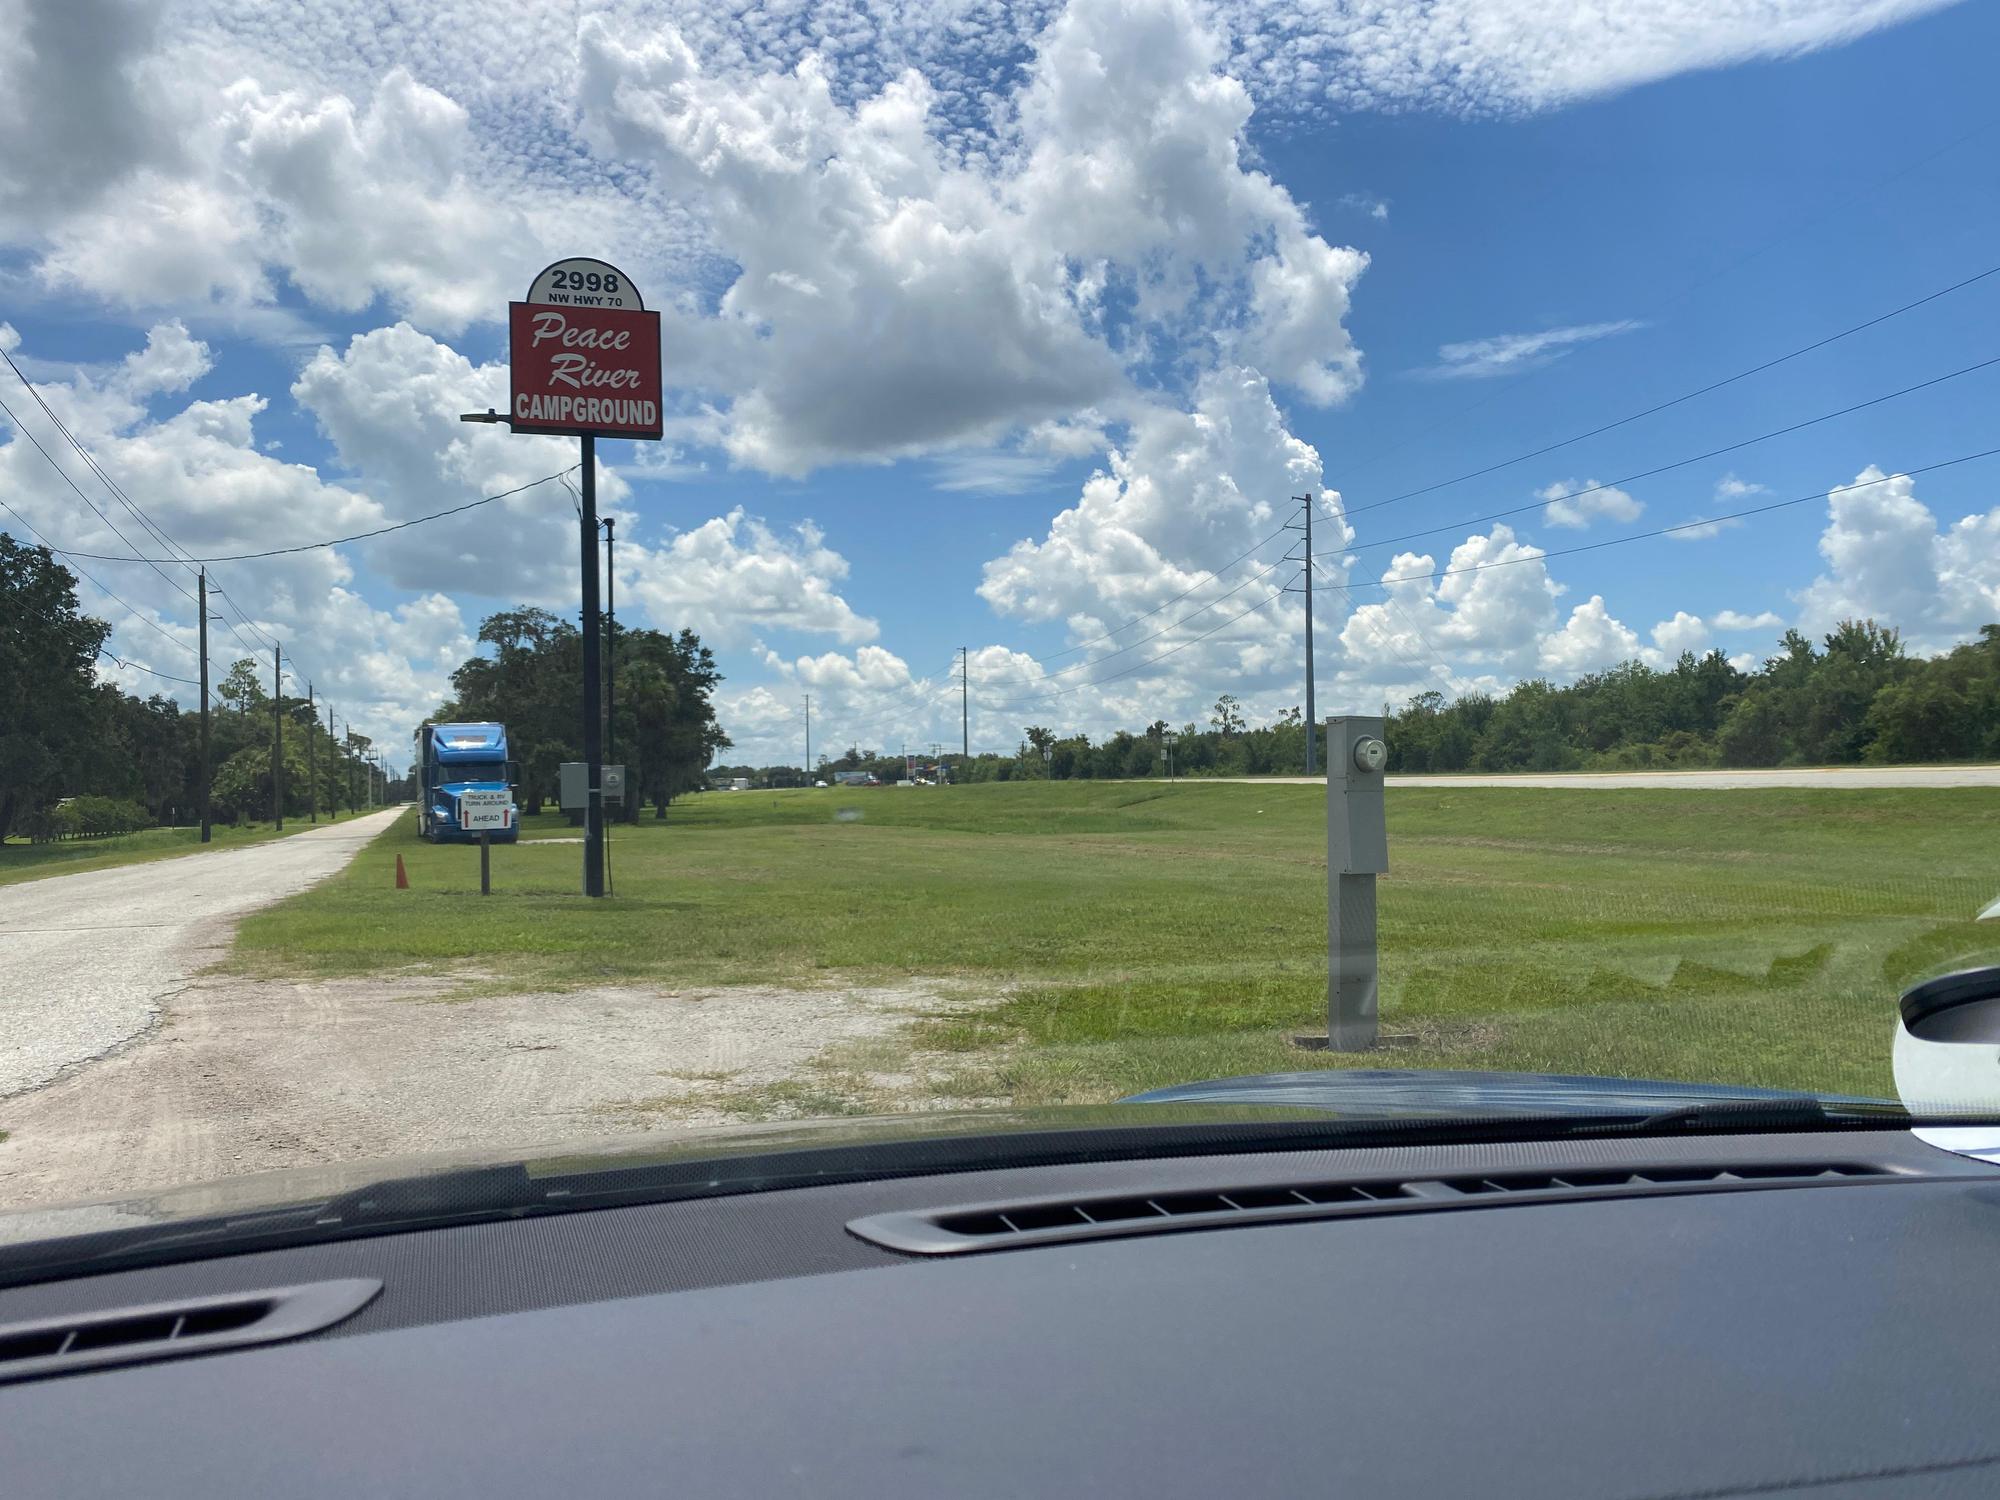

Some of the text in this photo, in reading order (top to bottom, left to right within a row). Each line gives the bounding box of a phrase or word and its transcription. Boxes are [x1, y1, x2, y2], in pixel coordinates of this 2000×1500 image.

[551, 270, 619, 293] 2998
[548, 293, 623, 307] NW HWY 70
[531, 312, 631, 350] Peace
[548, 353, 641, 389] River
[515, 393, 656, 425] CAMPGROUND
